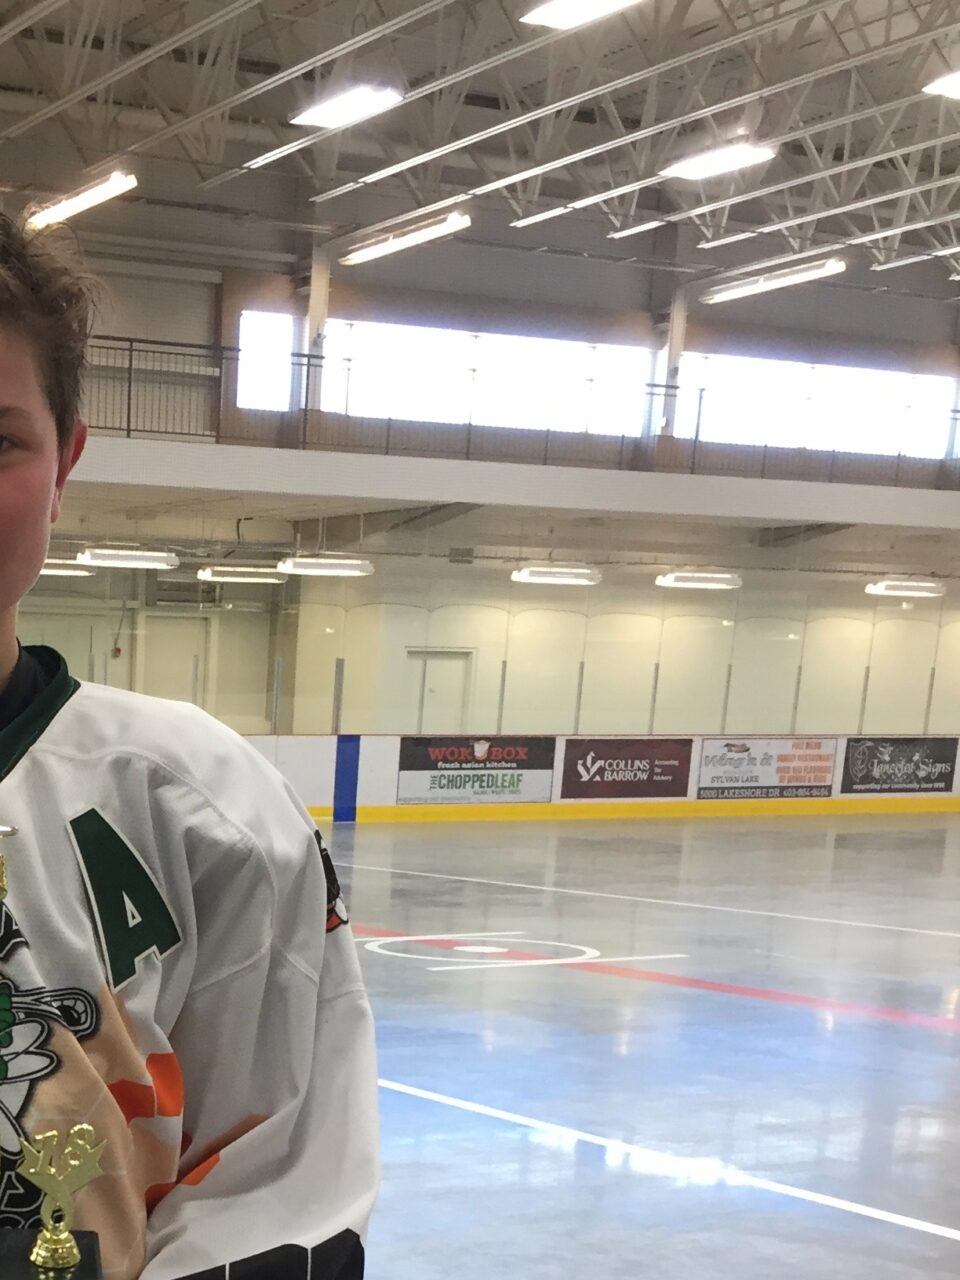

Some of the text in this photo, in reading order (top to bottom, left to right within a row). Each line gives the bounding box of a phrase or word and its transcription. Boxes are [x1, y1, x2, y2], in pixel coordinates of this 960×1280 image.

[427, 746, 529, 761] WOK BOX
[437, 761, 461, 769] fresh
[461, 761, 485, 769] asian
[605, 759, 650, 770] COLLINS
[603, 770, 650, 781] BARROW
[710, 775, 759, 784] SYLVAN LAKE
[718, 787, 767, 798] LAKESHORE
[768, 787, 780, 797] DR
[69, 807, 182, 990] A
